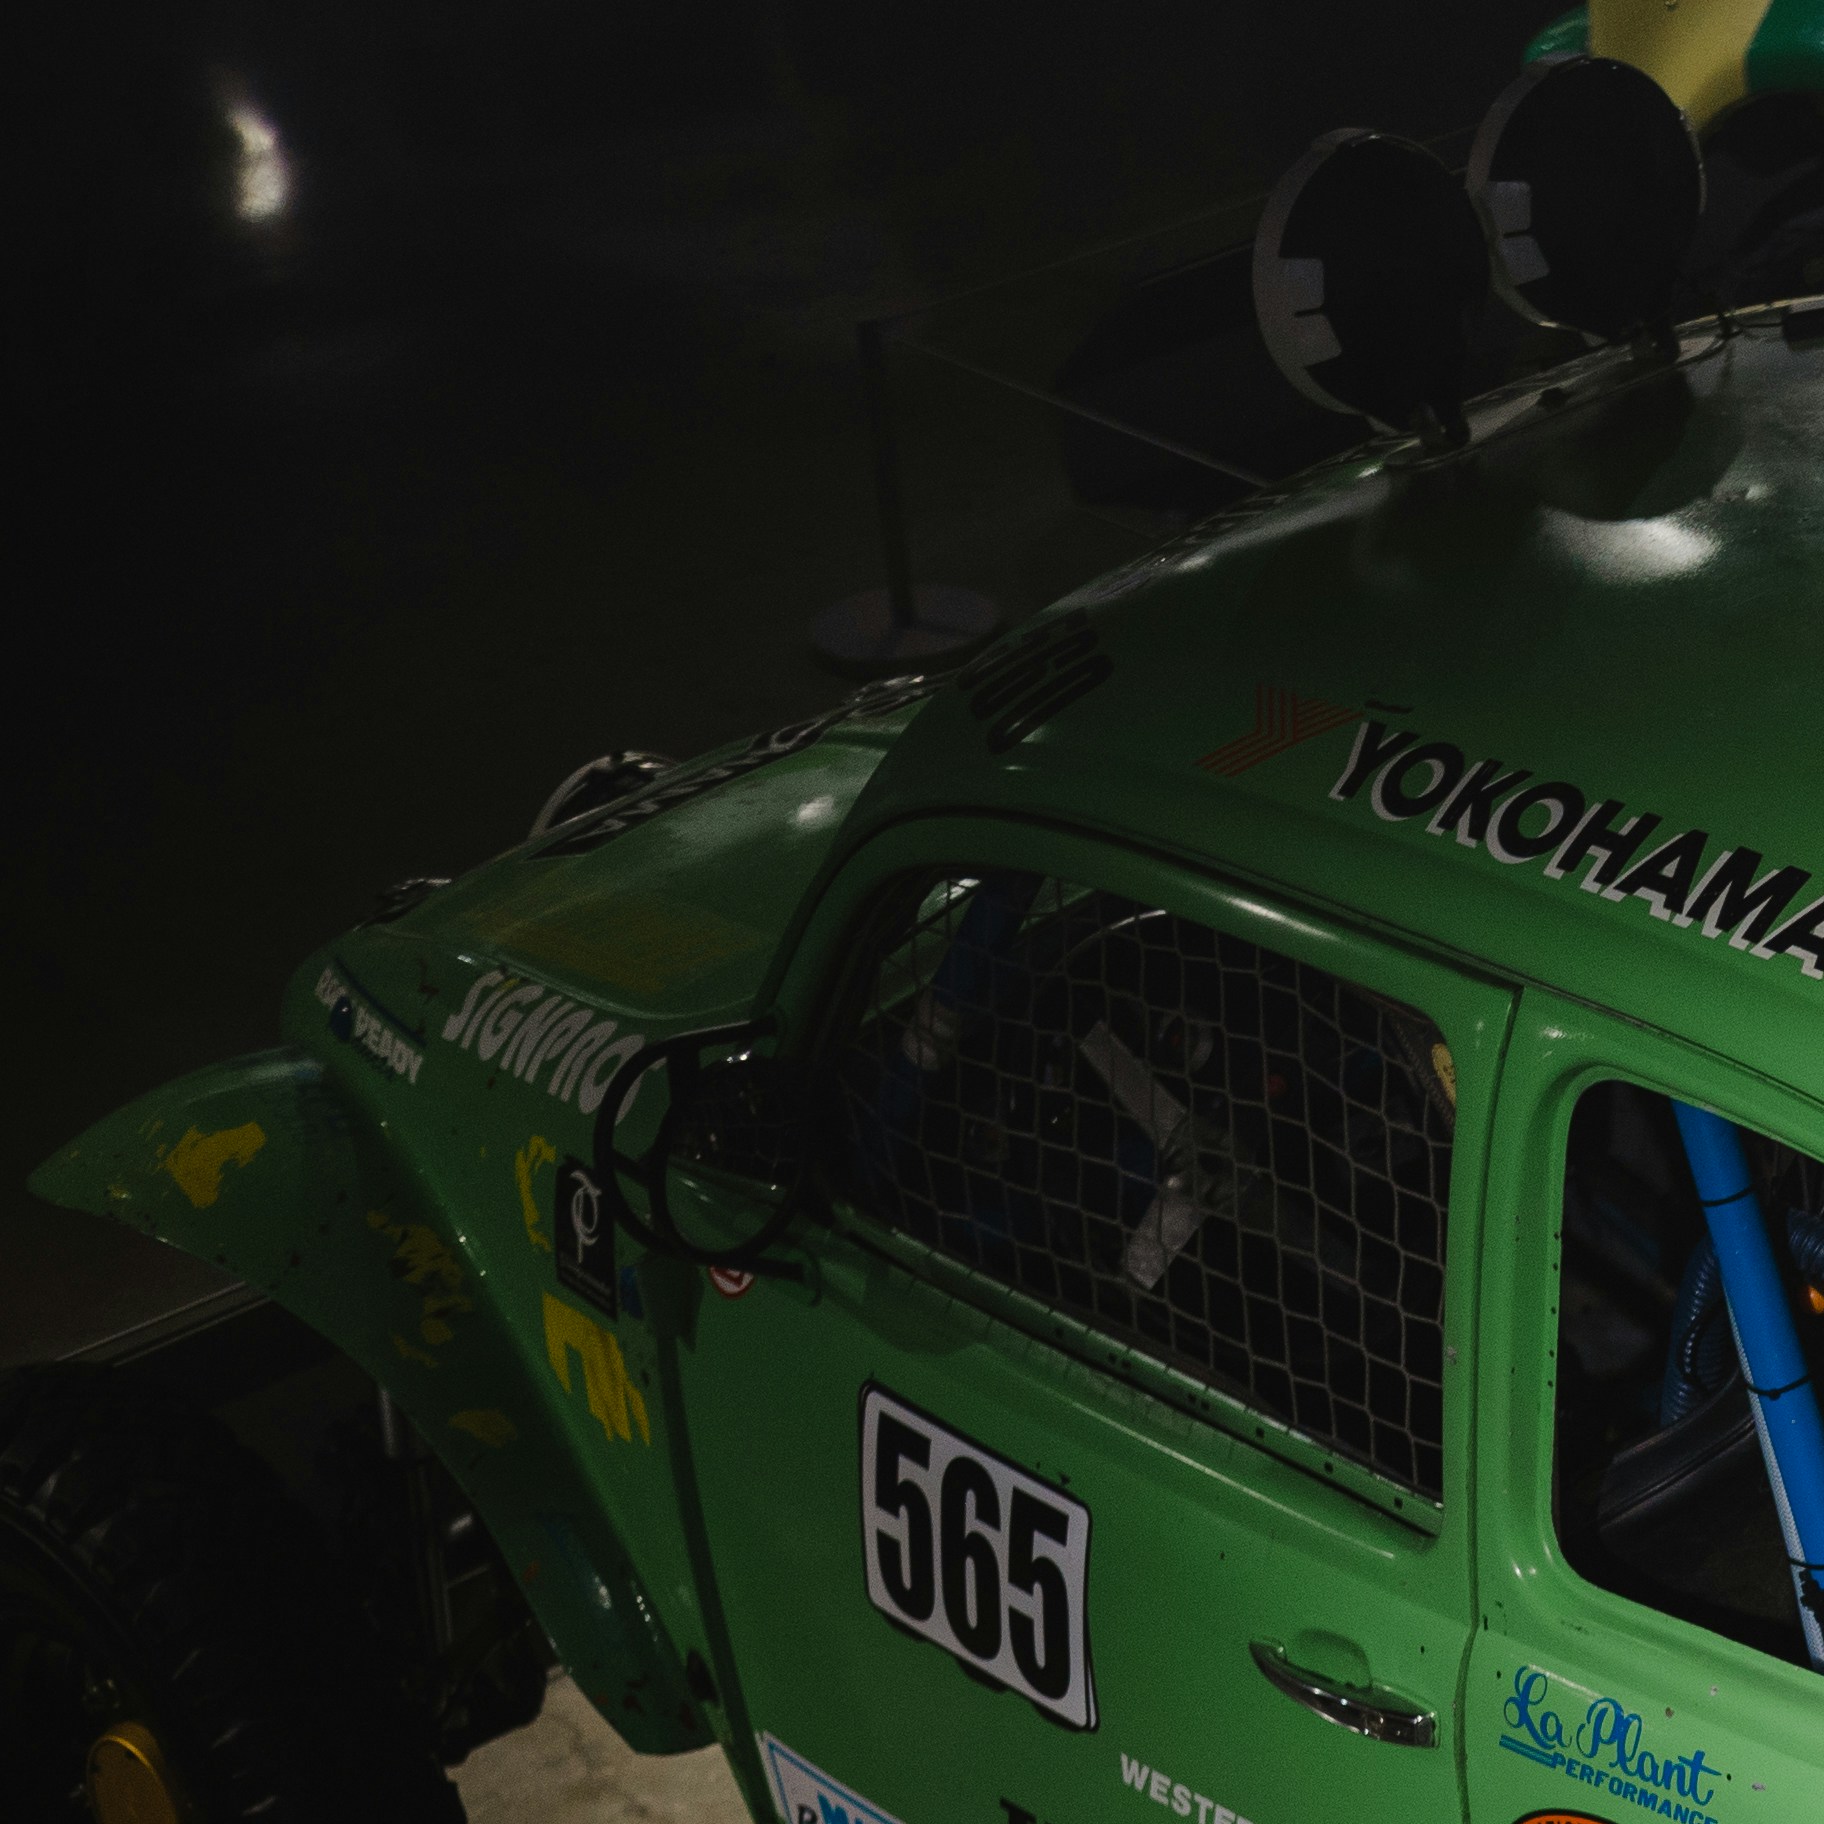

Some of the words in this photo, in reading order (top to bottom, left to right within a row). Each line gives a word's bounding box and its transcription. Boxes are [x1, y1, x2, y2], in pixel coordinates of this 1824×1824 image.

[873, 1409, 1072, 1702] 565
[1504, 1666, 1572, 1749] La
[1576, 1697, 1722, 1806] Plant
